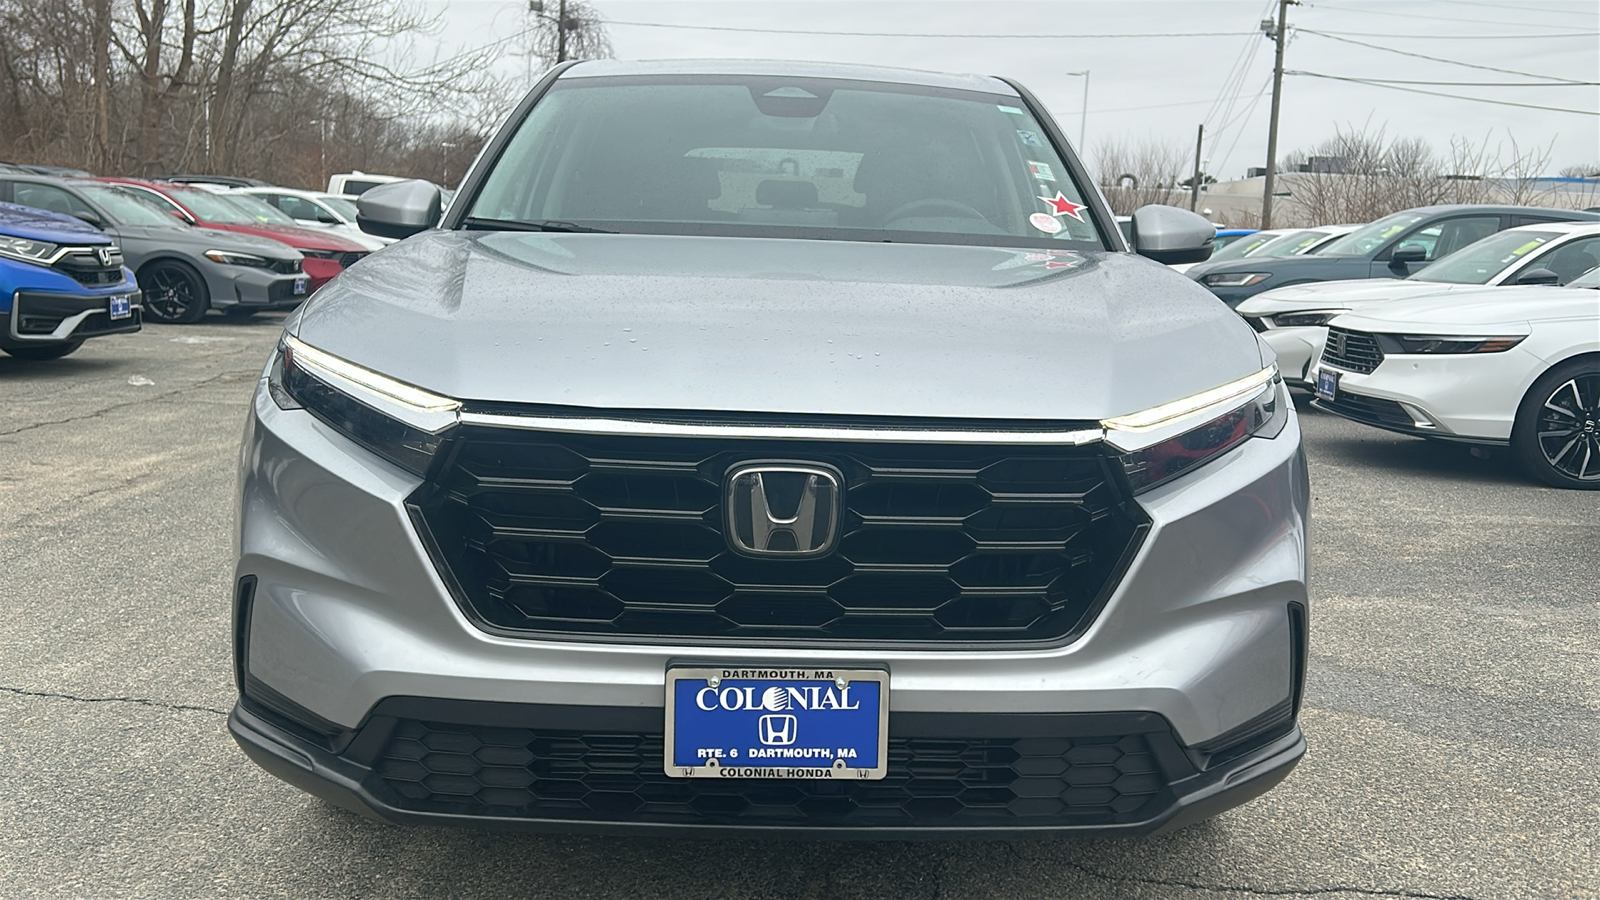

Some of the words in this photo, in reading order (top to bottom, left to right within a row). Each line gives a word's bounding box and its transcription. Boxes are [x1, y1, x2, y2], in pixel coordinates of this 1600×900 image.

[722, 670, 809, 679] DARTMOUTH,
[814, 671, 834, 679] MA
[695, 686, 860, 711] COLONIAL
[697, 748, 726, 758] RTE.
[729, 748, 738, 758] 6
[748, 748, 834, 759] DARTMOUTH,
[837, 749, 857, 758] MA
[719, 768, 783, 778] COLONIAL
[787, 769, 832, 778] HONDA
